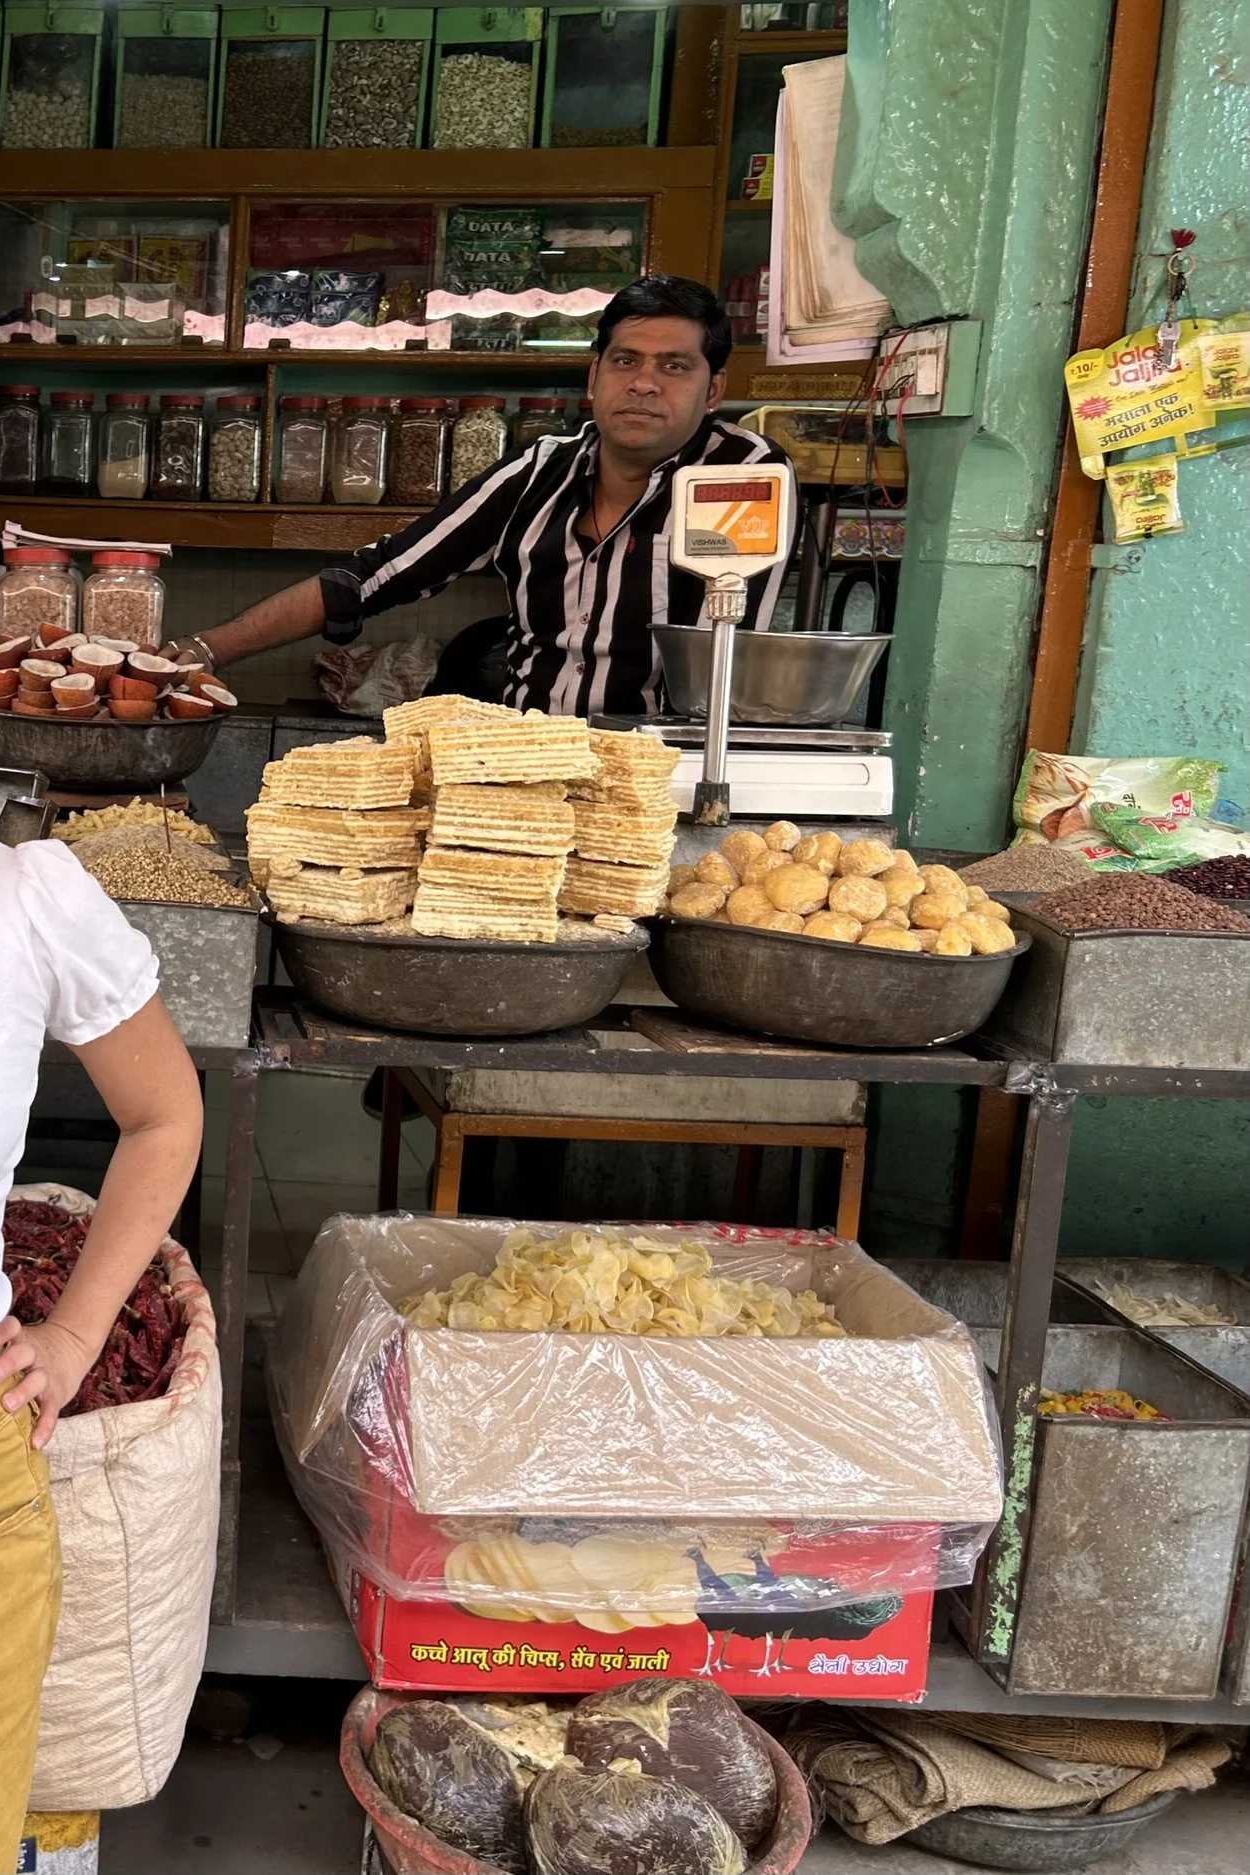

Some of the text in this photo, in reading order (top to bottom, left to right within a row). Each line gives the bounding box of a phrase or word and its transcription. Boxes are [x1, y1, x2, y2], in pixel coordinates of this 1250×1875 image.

[469, 222, 514, 232] DATA
[1098, 404, 1194, 447] उपयोग अनेक!
[1103, 404, 1152, 427] मसाला
[1154, 393, 1178, 408] एक
[411, 1640, 670, 1672] कच्चे आलू की चिप्स, सेंव एवं जाली
[808, 1653, 849, 1674] सैनी
